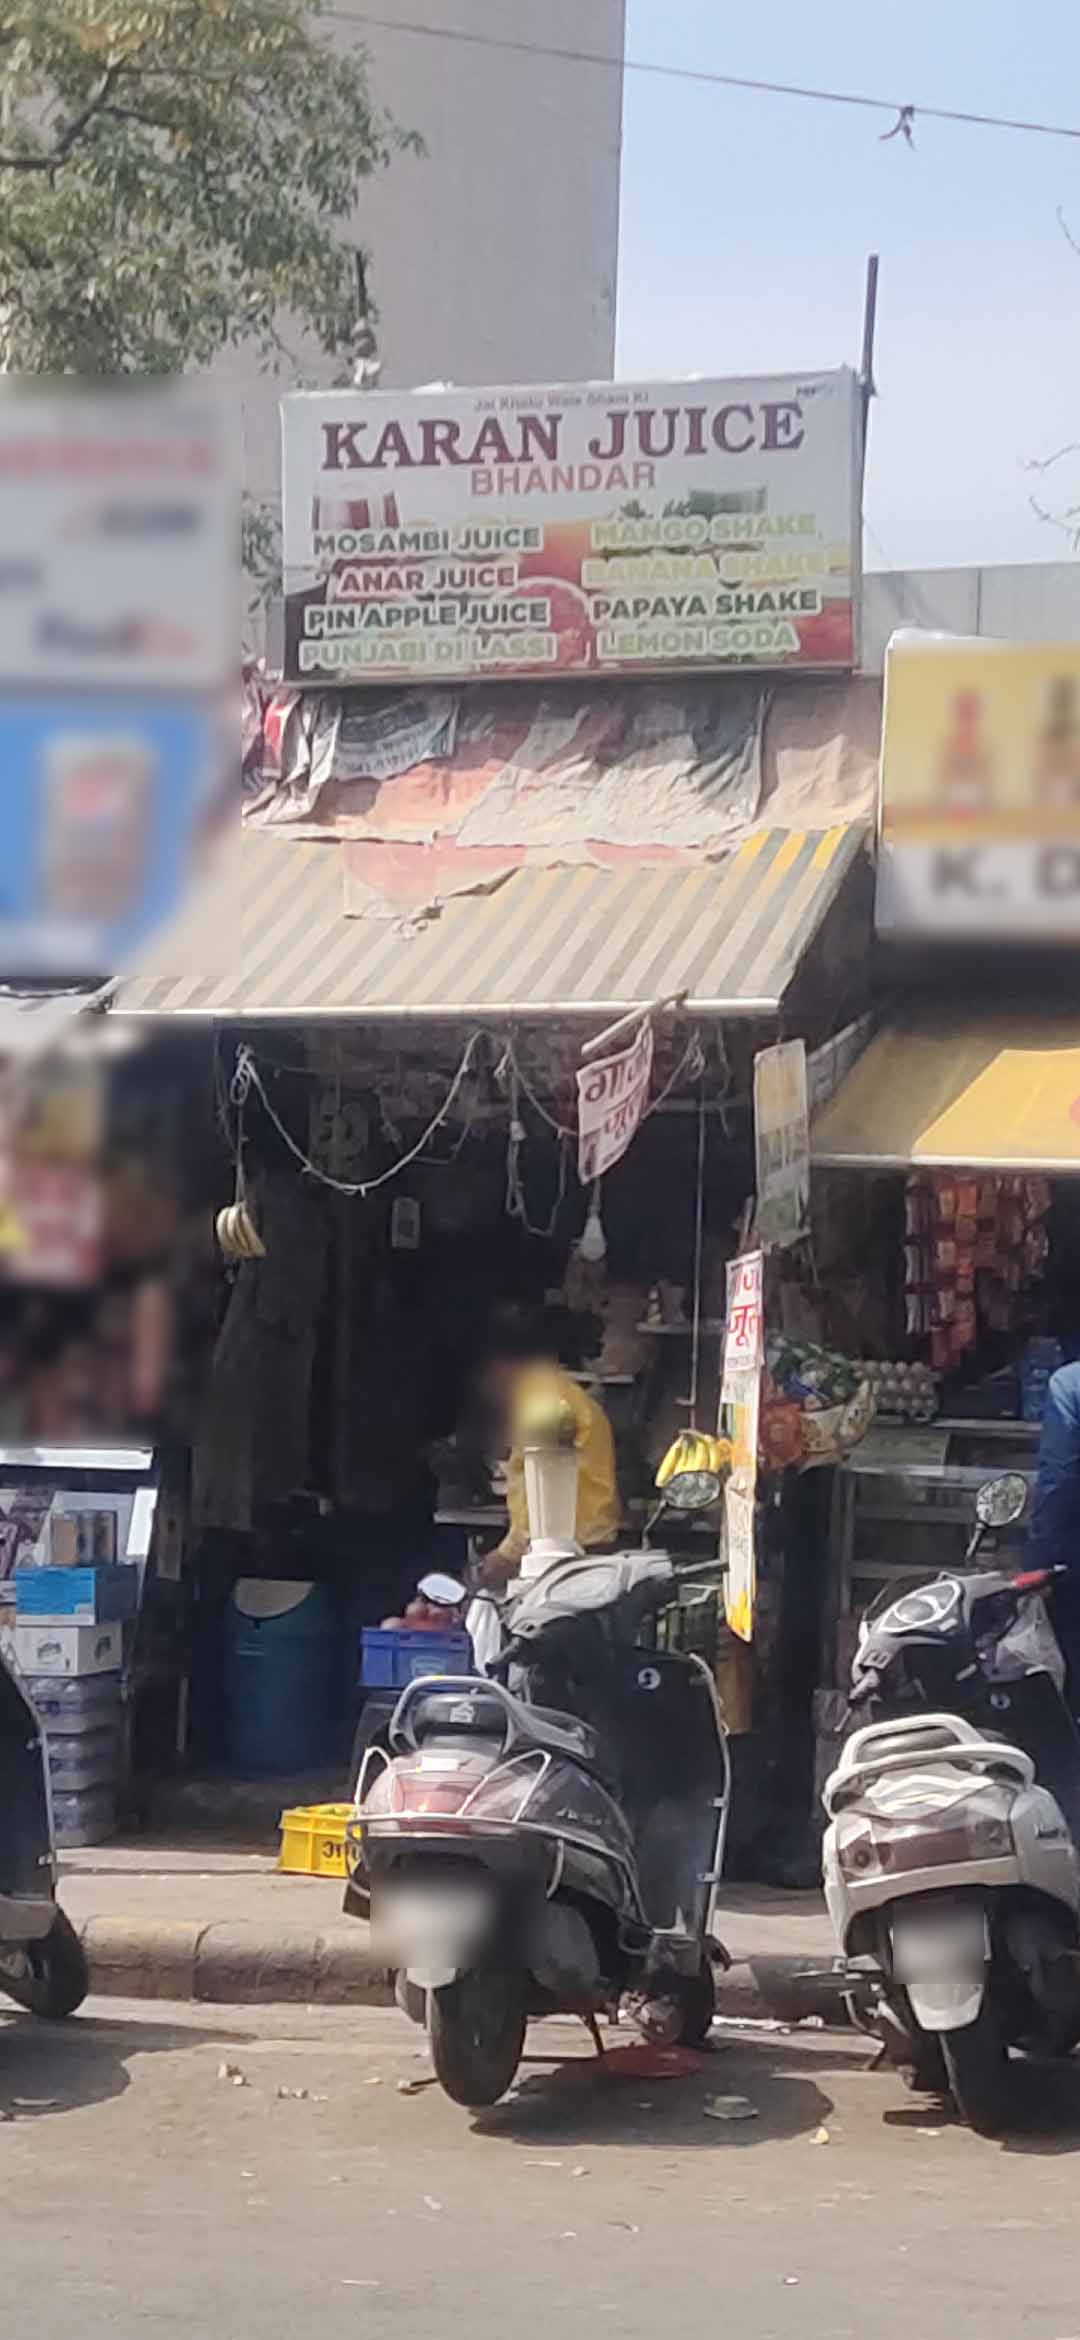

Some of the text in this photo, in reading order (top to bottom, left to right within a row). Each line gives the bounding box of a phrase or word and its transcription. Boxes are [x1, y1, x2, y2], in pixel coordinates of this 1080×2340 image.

[321, 402, 805, 470] KARAN JUICE
[470, 462, 656, 496] BHANDAR
[313, 527, 541, 555] MOSAMBI JUICE
[595, 518, 702, 543] MANGO
[340, 567, 516, 593] ANAR JUICE
[308, 602, 548, 630] PIN APPLE JUICE
[592, 590, 818, 620] PAPAYA SHAKE
[302, 636, 555, 665] PUNJABI DI LASSI
[601, 626, 796, 655] LEMON SODA
